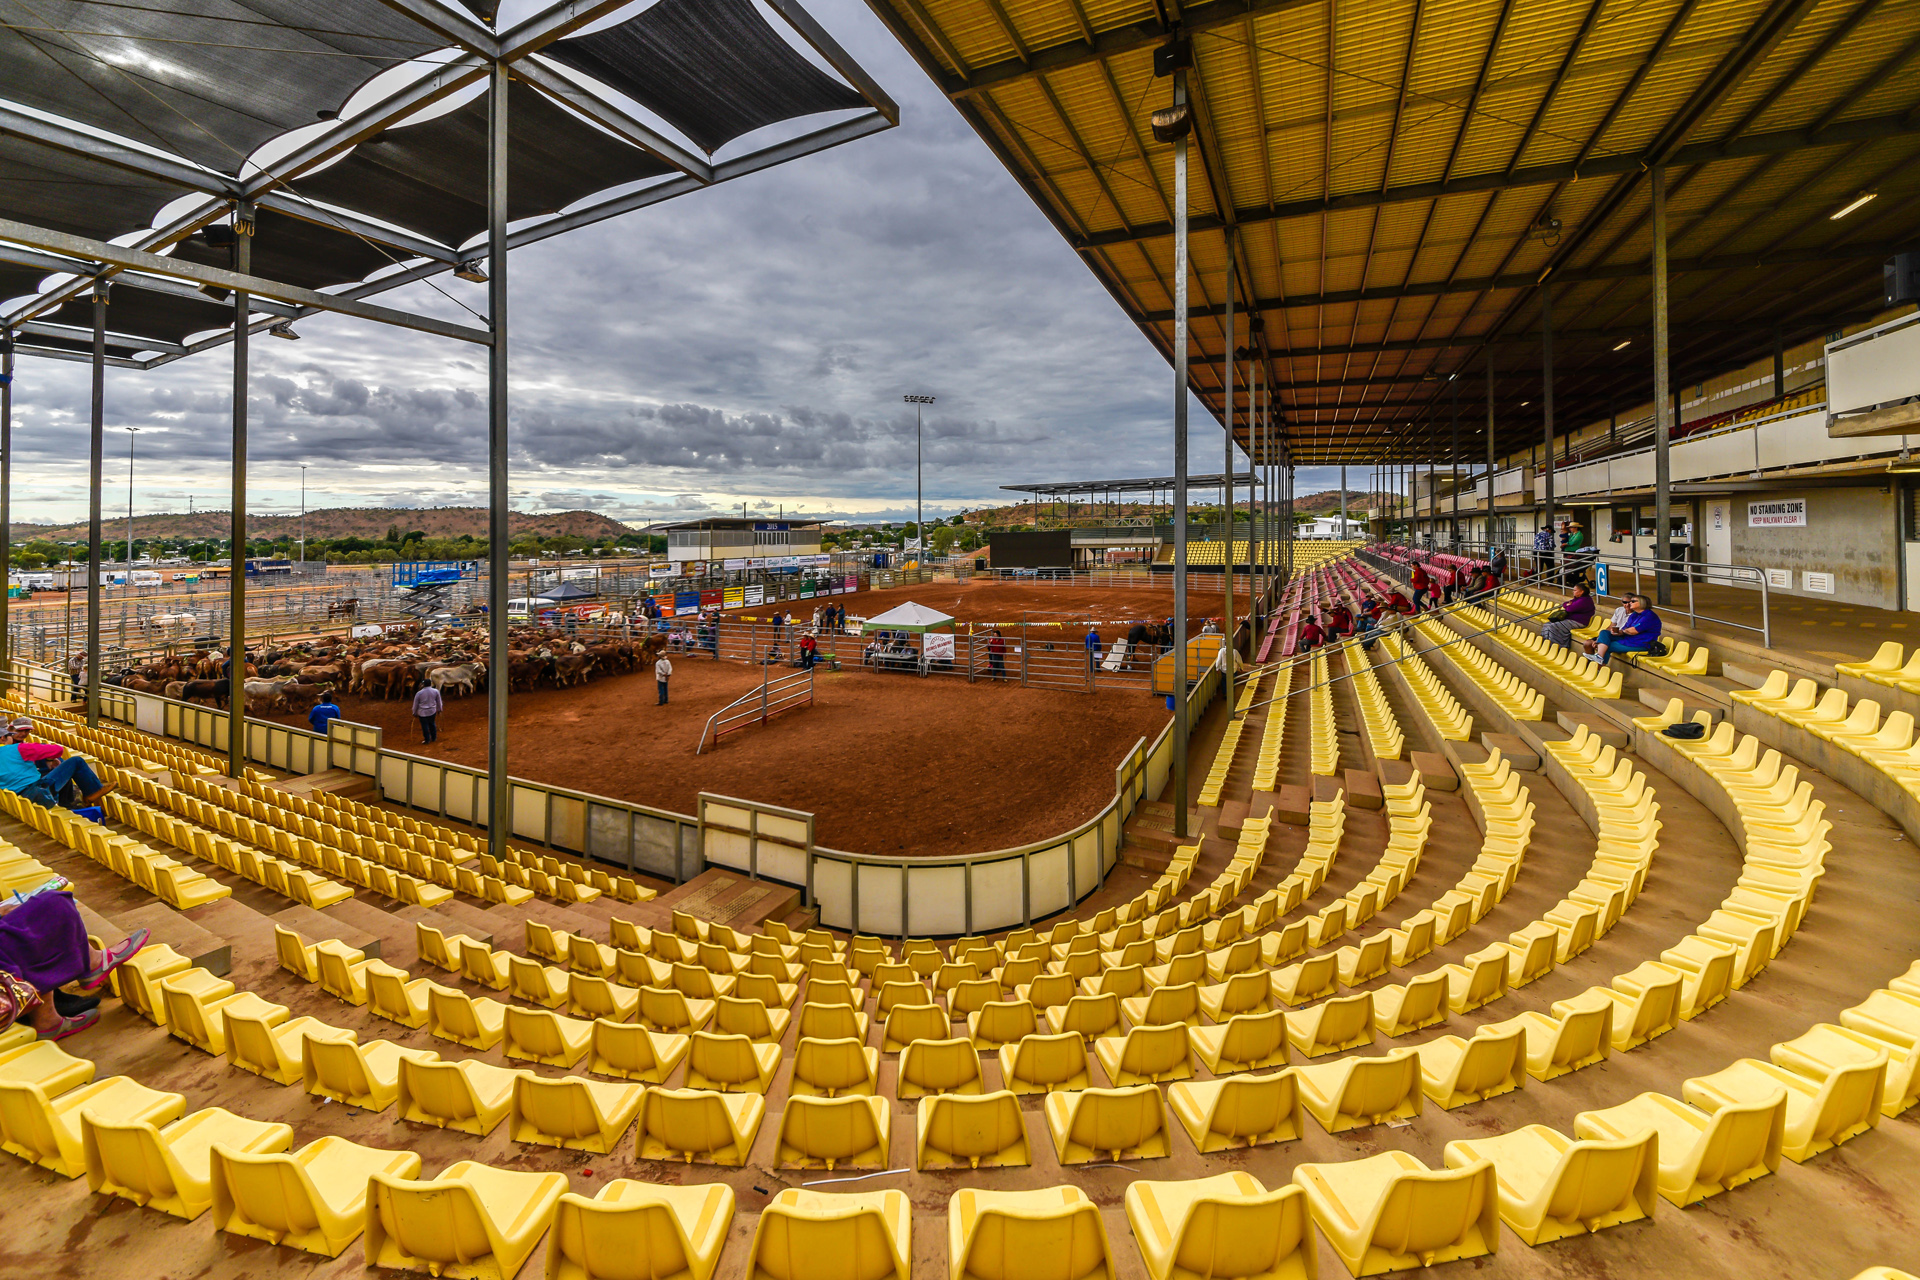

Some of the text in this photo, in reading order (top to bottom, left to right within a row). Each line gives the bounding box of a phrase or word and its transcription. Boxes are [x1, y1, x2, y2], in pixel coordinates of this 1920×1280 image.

[1750, 502, 1803, 515] NO STANDING ZONE
[1753, 517, 1763, 525] KEEP
[1763, 516, 1783, 524] WALKWAY
[1784, 515, 1798, 524] CLEAR
[766, 522, 778, 530] 2015
[1597, 566, 1606, 592] G
[386, 624, 406, 633] PETS
